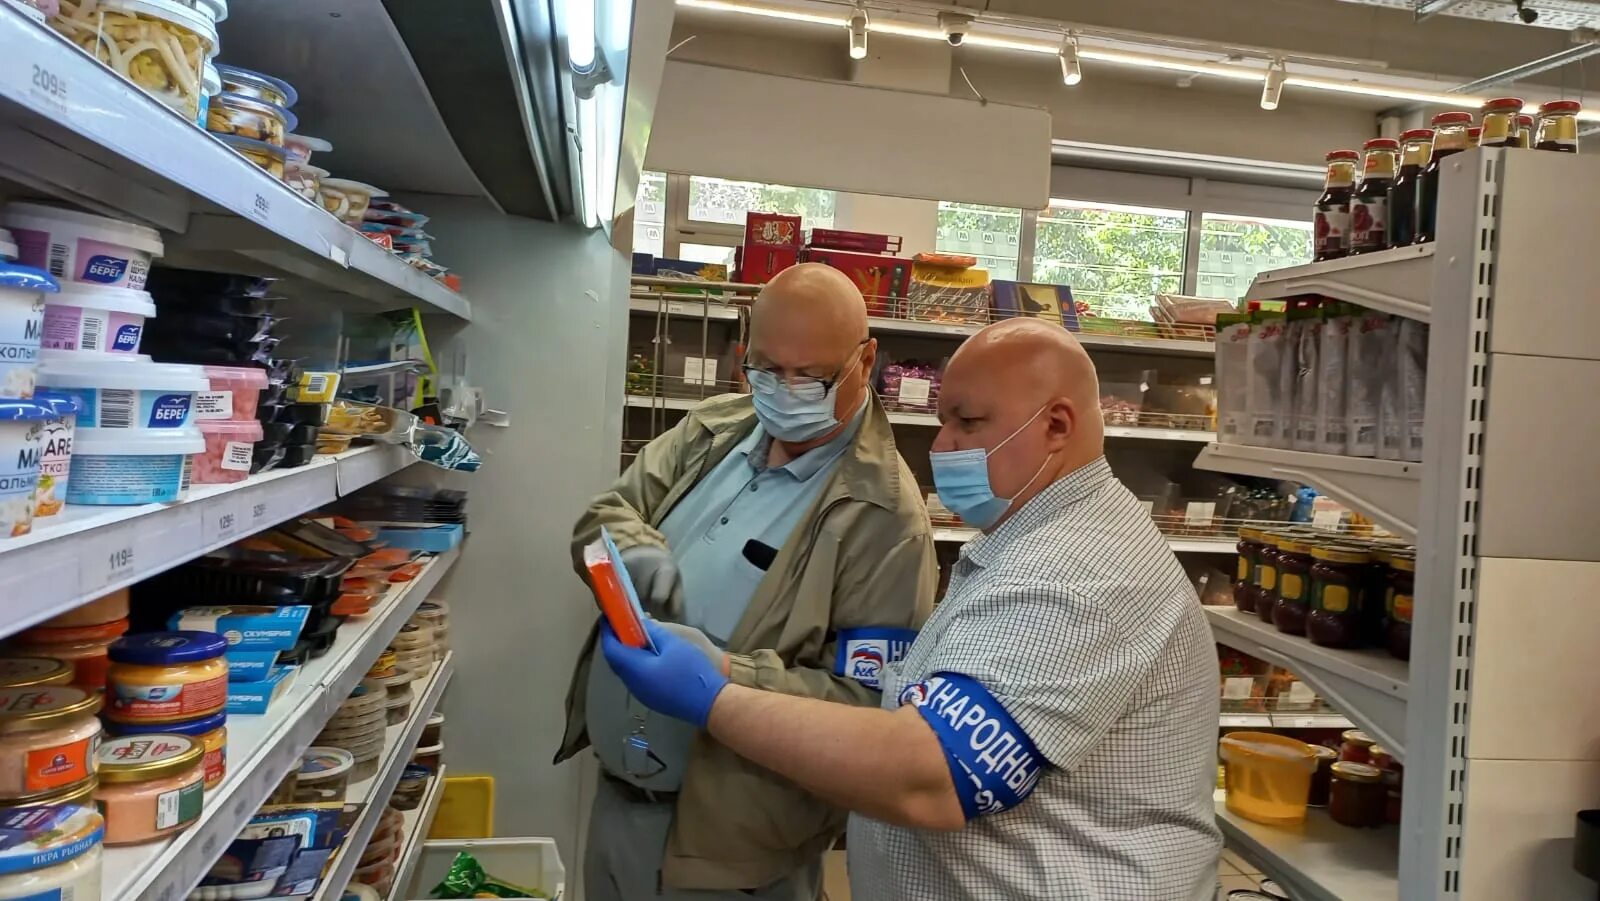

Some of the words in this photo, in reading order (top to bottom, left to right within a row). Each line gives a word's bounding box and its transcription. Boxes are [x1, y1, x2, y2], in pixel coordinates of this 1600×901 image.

[90, 265, 121, 278] БЕРЕГ
[156, 408, 187, 420] БЕРЕГ
[109, 550, 126, 569] 119
[32, 852, 58, 865] ИКРА
